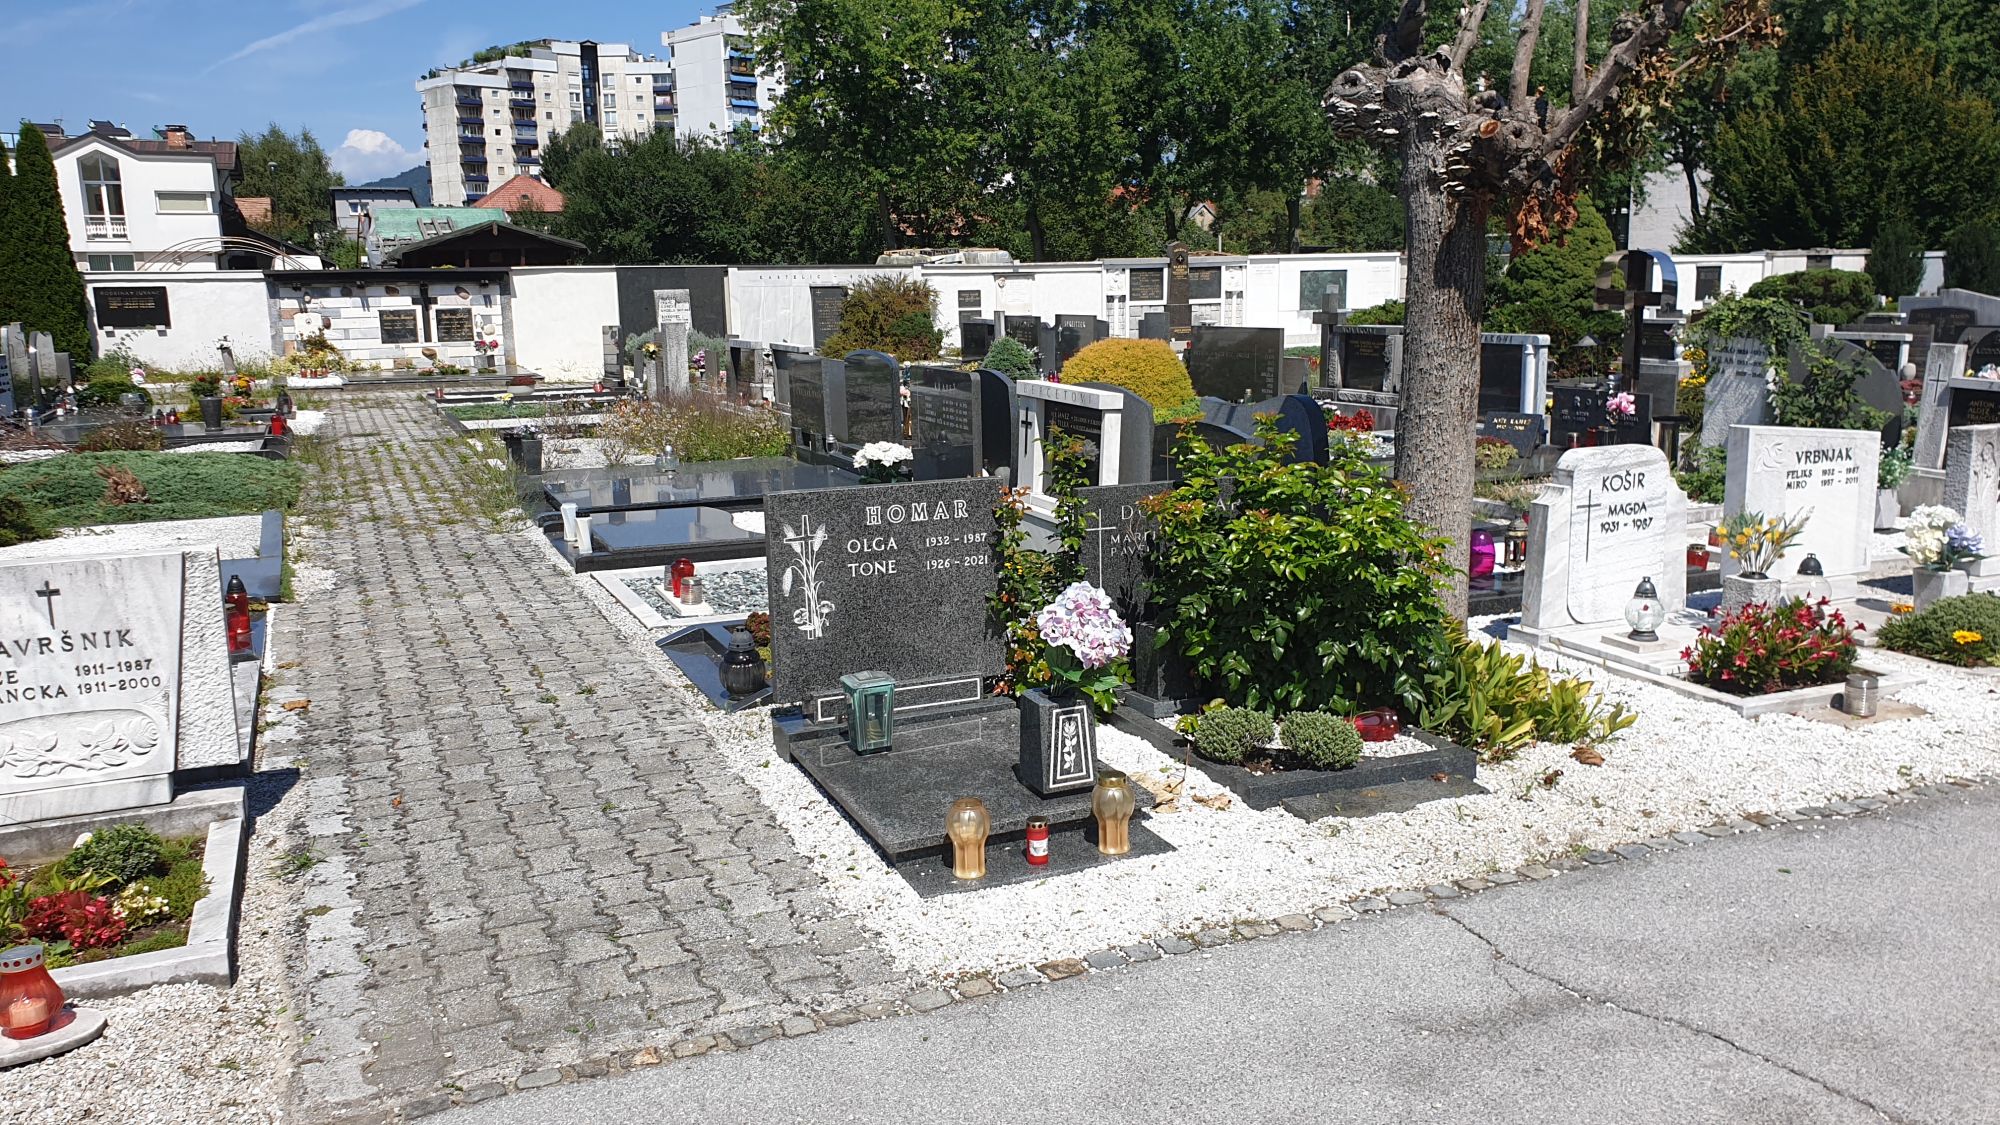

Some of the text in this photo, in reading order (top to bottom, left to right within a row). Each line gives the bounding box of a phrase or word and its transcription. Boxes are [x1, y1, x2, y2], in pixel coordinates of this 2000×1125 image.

[1795, 446, 1854, 466] VRBNJAK
[1601, 469, 1646, 493] KOŠIR
[1785, 468, 1813, 481] FELIKS
[1785, 479, 1808, 491] MIRO
[865, 499, 969, 526] HOMAR
[1607, 501, 1648, 518] MAGDA
[1600, 520, 1620, 534] 1931
[1631, 516, 1654, 531] 1987
[847, 536, 898, 554] OLGA
[926, 535, 951, 548] 1932
[963, 531, 987, 544] 1987
[847, 559, 898, 578] TONE
[926, 558, 951, 571] 1926
[964, 554, 988, 567] 2021
[75, 658, 153, 677] 1911-1987
[77, 675, 162, 696] 1911-2000
